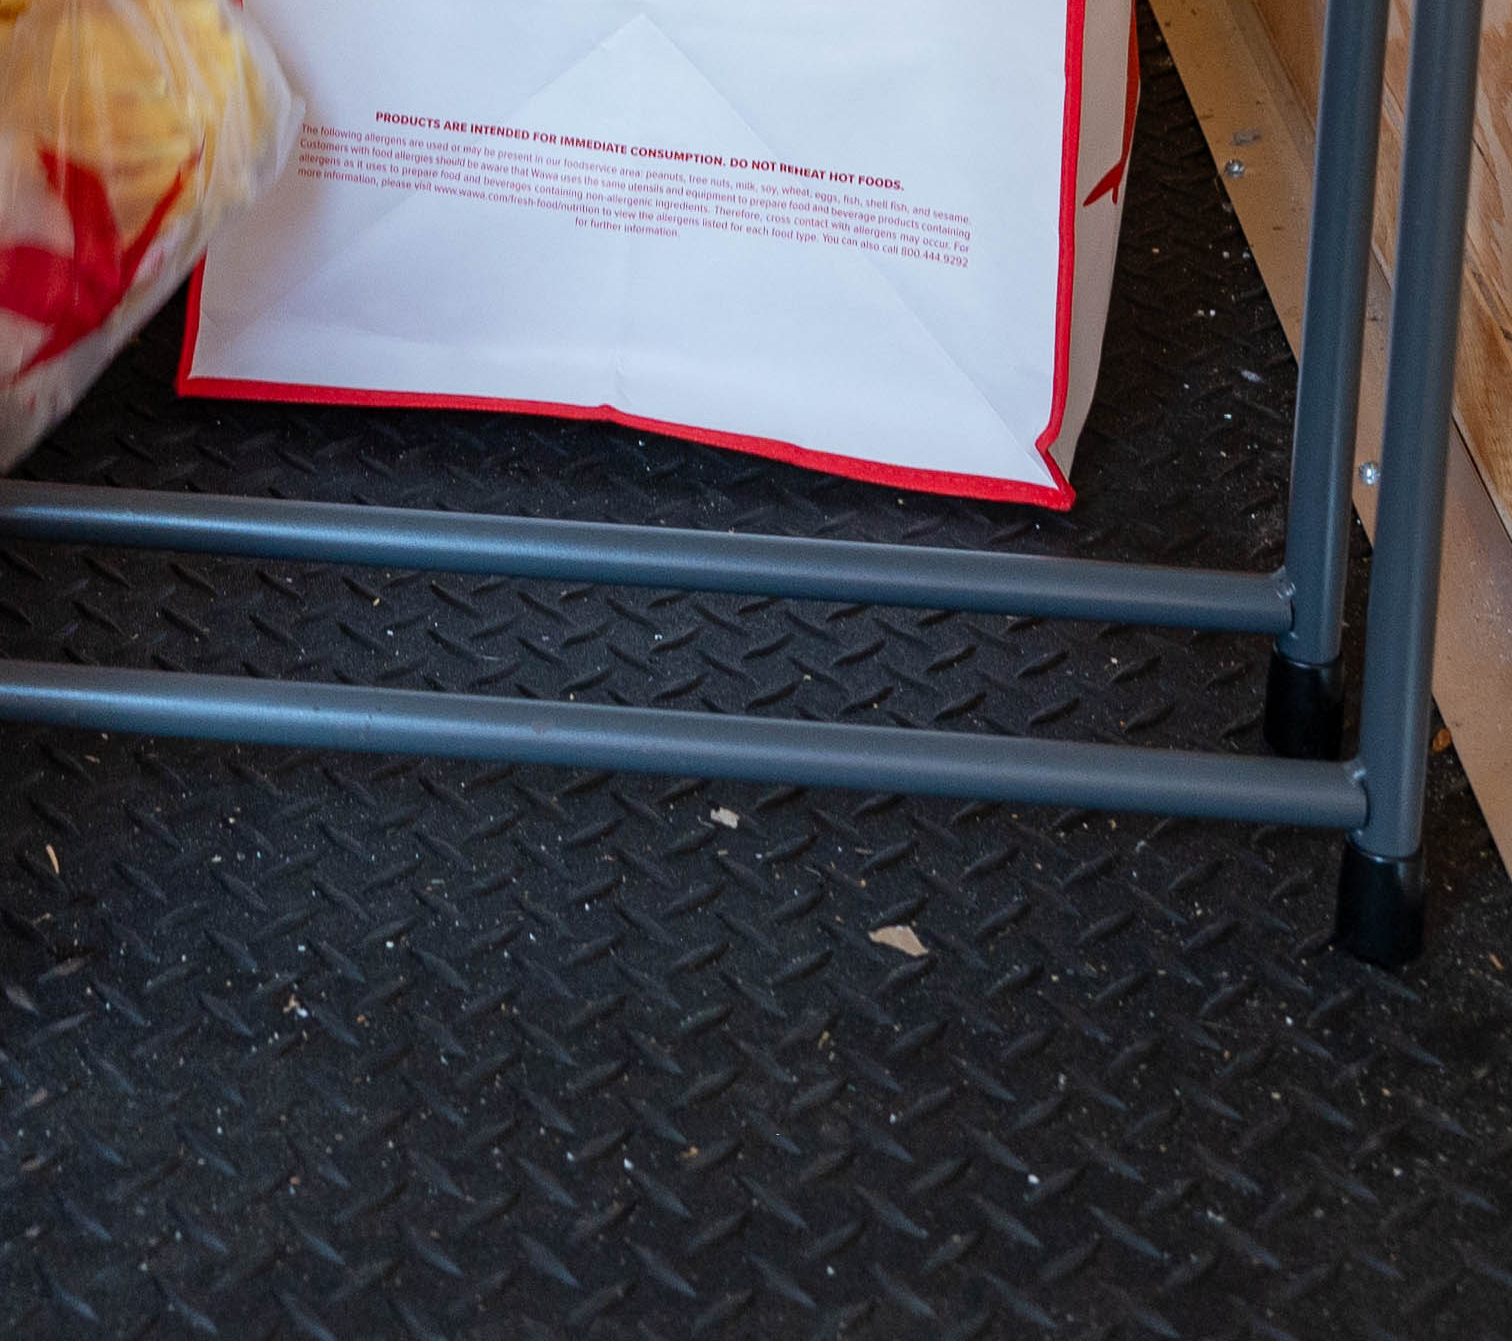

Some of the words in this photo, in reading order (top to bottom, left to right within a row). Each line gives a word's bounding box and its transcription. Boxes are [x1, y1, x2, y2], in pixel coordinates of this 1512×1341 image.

[376, 111, 440, 129] PRODUCTS
[444, 120, 467, 133] ARE
[471, 123, 529, 141] INTENDED
[533, 132, 556, 145] FOR
[560, 136, 626, 155] IMMEDIATE
[730, 157, 747, 169] DO
[752, 160, 776, 173] NOT
[780, 163, 825, 180] REHEAT
[829, 170, 855, 184] HOT
